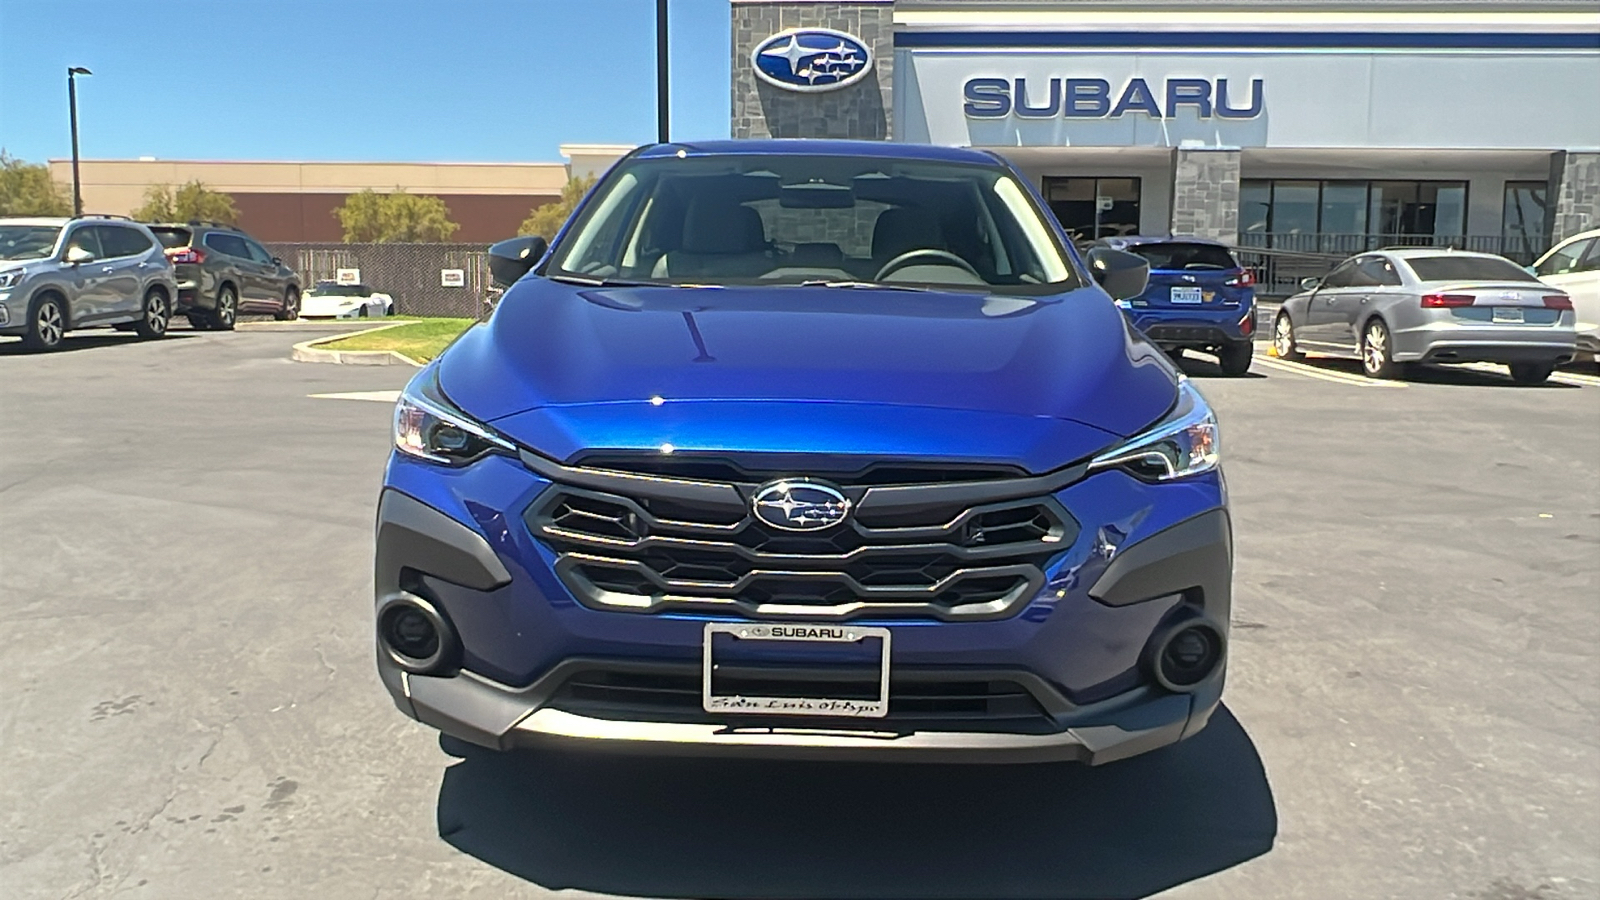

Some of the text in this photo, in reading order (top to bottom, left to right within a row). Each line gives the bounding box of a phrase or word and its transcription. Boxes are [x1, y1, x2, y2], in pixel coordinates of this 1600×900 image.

[963, 77, 1264, 119] SUBARU
[771, 627, 843, 639] SUBARU
[764, 700, 813, 710] Luis
